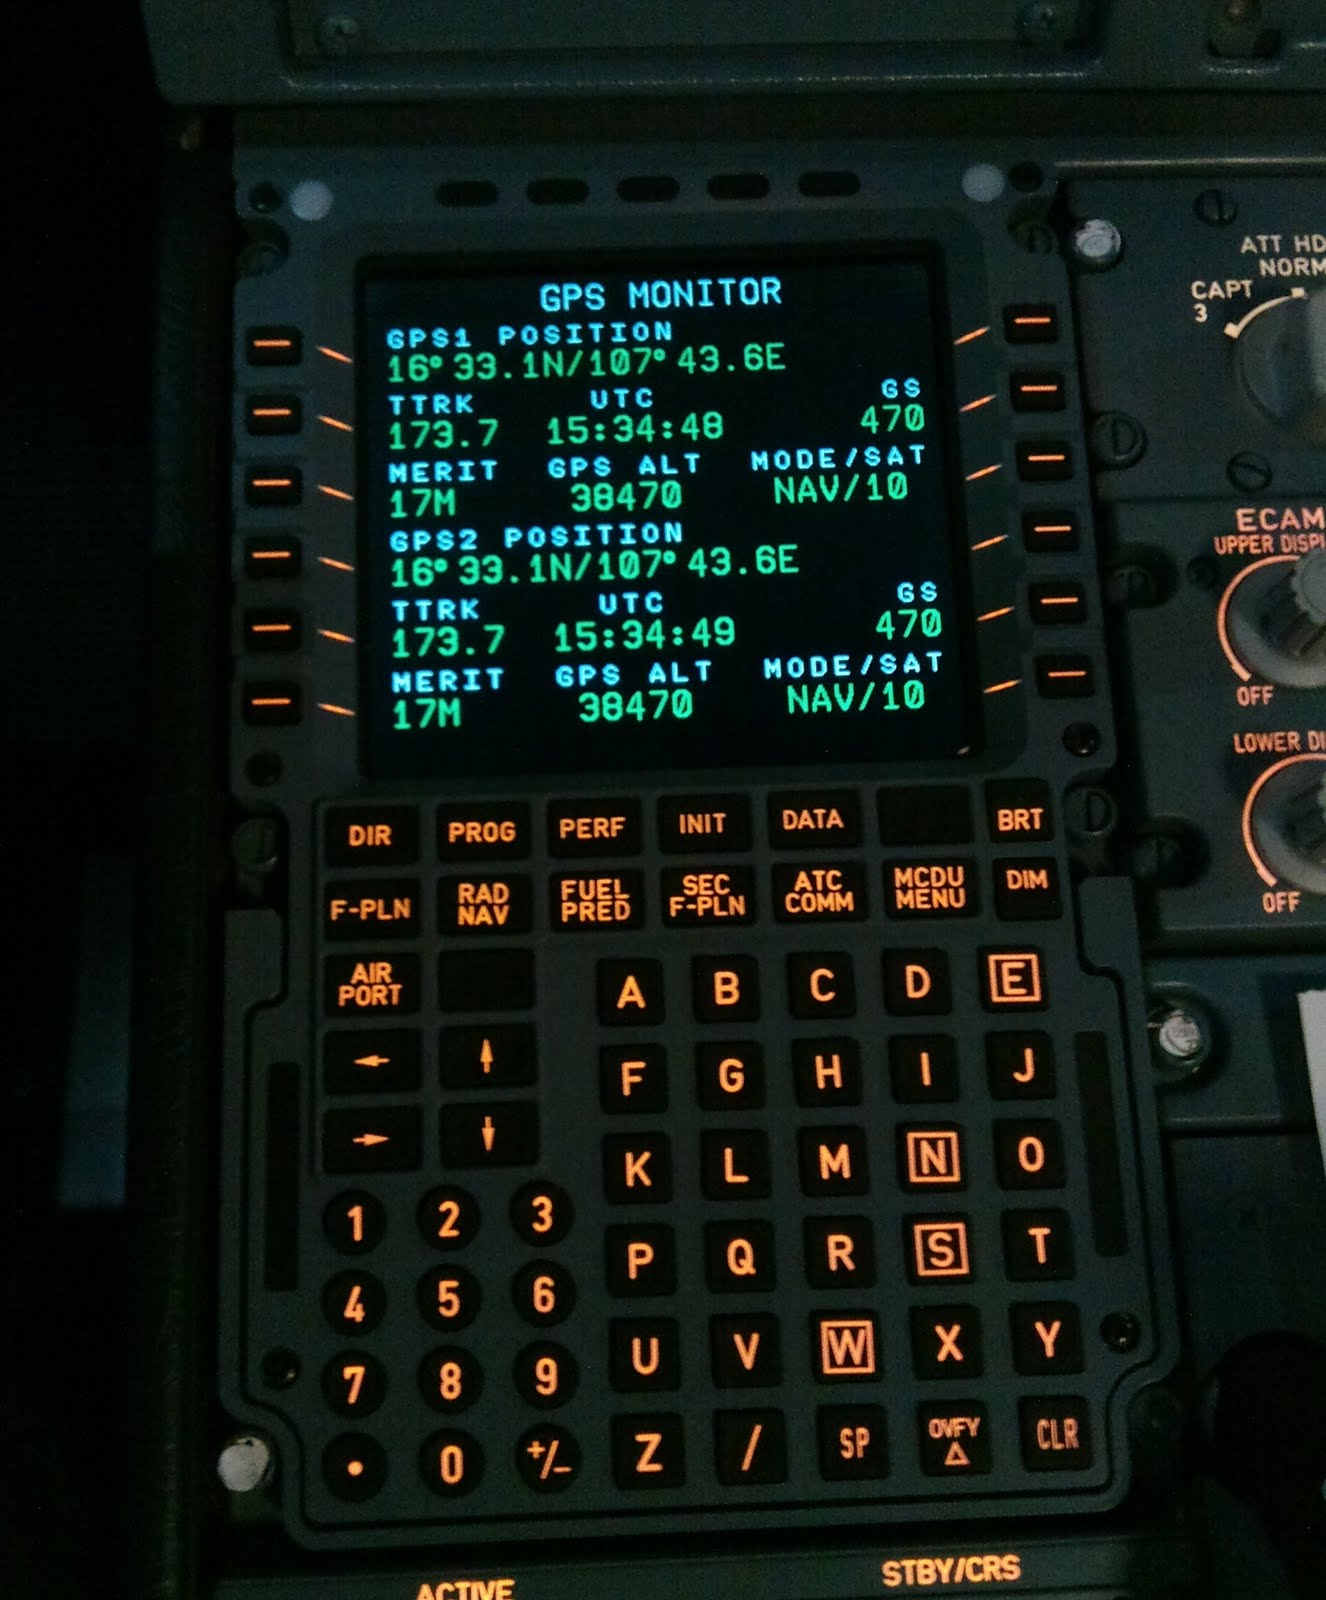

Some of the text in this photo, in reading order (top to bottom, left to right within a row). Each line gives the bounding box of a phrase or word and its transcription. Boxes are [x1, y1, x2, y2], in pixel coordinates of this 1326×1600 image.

[1241, 233, 1326, 254] ATT HD
[1259, 257, 1326, 277] NORM
[539, 277, 782, 312] GPS MONITOR
[1191, 279, 1253, 300] CAPT
[1193, 304, 1208, 323] 3
[386, 322, 672, 349] GPS1 POSITION
[590, 388, 654, 409] UTC
[882, 378, 921, 398] GS
[389, 394, 474, 415] TTRK
[860, 405, 925, 434] 470
[388, 420, 498, 450] 173.7
[547, 412, 724, 445] 15:34:48
[388, 460, 498, 484] MERIT
[548, 453, 700, 478] GPS ALT
[750, 444, 926, 471] MODE/SAT
[570, 480, 683, 514] 38470
[774, 472, 908, 504] NAV/10
[390, 490, 456, 517] 17M
[1236, 507, 1325, 532] ECAM
[390, 523, 684, 552] GPS2 POSITION
[1213, 534, 1274, 555] UPPER
[598, 592, 664, 614] UTC
[897, 582, 938, 603] GS
[392, 600, 480, 621] TTRK
[876, 610, 942, 640] 470
[392, 625, 505, 658] 173.7
[554, 616, 736, 652] 15:34:49
[392, 668, 504, 693] MERIT
[554, 661, 712, 687] GPS ALT
[764, 653, 943, 679] MODE/SAT
[578, 692, 694, 722] 38470
[787, 680, 925, 714] NAV/10
[1236, 685, 1273, 706] OFF
[393, 700, 462, 730] 17M
[1233, 731, 1301, 754] LOWER
[449, 822, 515, 842] PROG
[560, 817, 625, 839] PERF
[680, 813, 726, 834] INIT
[783, 809, 843, 830] DATA
[998, 808, 1043, 831] BRT
[349, 825, 391, 846] DIR
[561, 879, 630, 901] FUEL
[682, 874, 730, 896] SEC
[794, 870, 842, 891] ATC
[894, 866, 965, 888] MCDU
[1007, 870, 1048, 889] DIM
[458, 882, 509, 904] RAD
[669, 896, 745, 918] F-PLN
[785, 891, 854, 913] COMM
[896, 888, 966, 910] MENU
[1262, 891, 1300, 913] OFF
[331, 899, 410, 920] F-PLN
[458, 904, 510, 926] NAV
[561, 901, 631, 922] PRED
[350, 962, 392, 984] AIR
[714, 971, 739, 1005] B
[811, 969, 835, 1001] C
[906, 965, 930, 998] D
[1001, 961, 1026, 995] E
[338, 984, 402, 1007] PORT
[617, 976, 645, 1008] A
[622, 1061, 646, 1096] F
[719, 1059, 744, 1092] G
[815, 1055, 842, 1089] H
[921, 1052, 931, 1085] I
[1014, 1048, 1034, 1082] J
[626, 1152, 651, 1187] K
[725, 1148, 749, 1183] L
[819, 1144, 850, 1179] M
[920, 1140, 947, 1175] N
[1018, 1137, 1044, 1172] O
[348, 1206, 362, 1241] 1
[439, 1201, 459, 1237] 2
[533, 1196, 552, 1232] 3
[728, 1239, 756, 1275] Q
[828, 1235, 855, 1270] R
[928, 1231, 954, 1268] S
[1028, 1228, 1050, 1263] T
[628, 1243, 653, 1279] P
[344, 1286, 365, 1322] 4
[439, 1280, 459, 1317] 5
[534, 1276, 554, 1313] 6
[734, 1333, 759, 1369] V
[828, 1329, 866, 1365] W
[935, 1325, 963, 1361] X
[1035, 1321, 1060, 1357] Y
[633, 1338, 658, 1375] U
[343, 1366, 365, 1403] 7
[440, 1362, 461, 1400] 8
[536, 1358, 557, 1395] 9
[840, 1427, 869, 1458] SP
[1037, 1412, 1079, 1450] CLR
[441, 1445, 463, 1483] 0
[636, 1433, 662, 1472] Z
[882, 1554, 1022, 1587] STBY/CRS
[416, 1579, 515, 1600] ACTIVE
